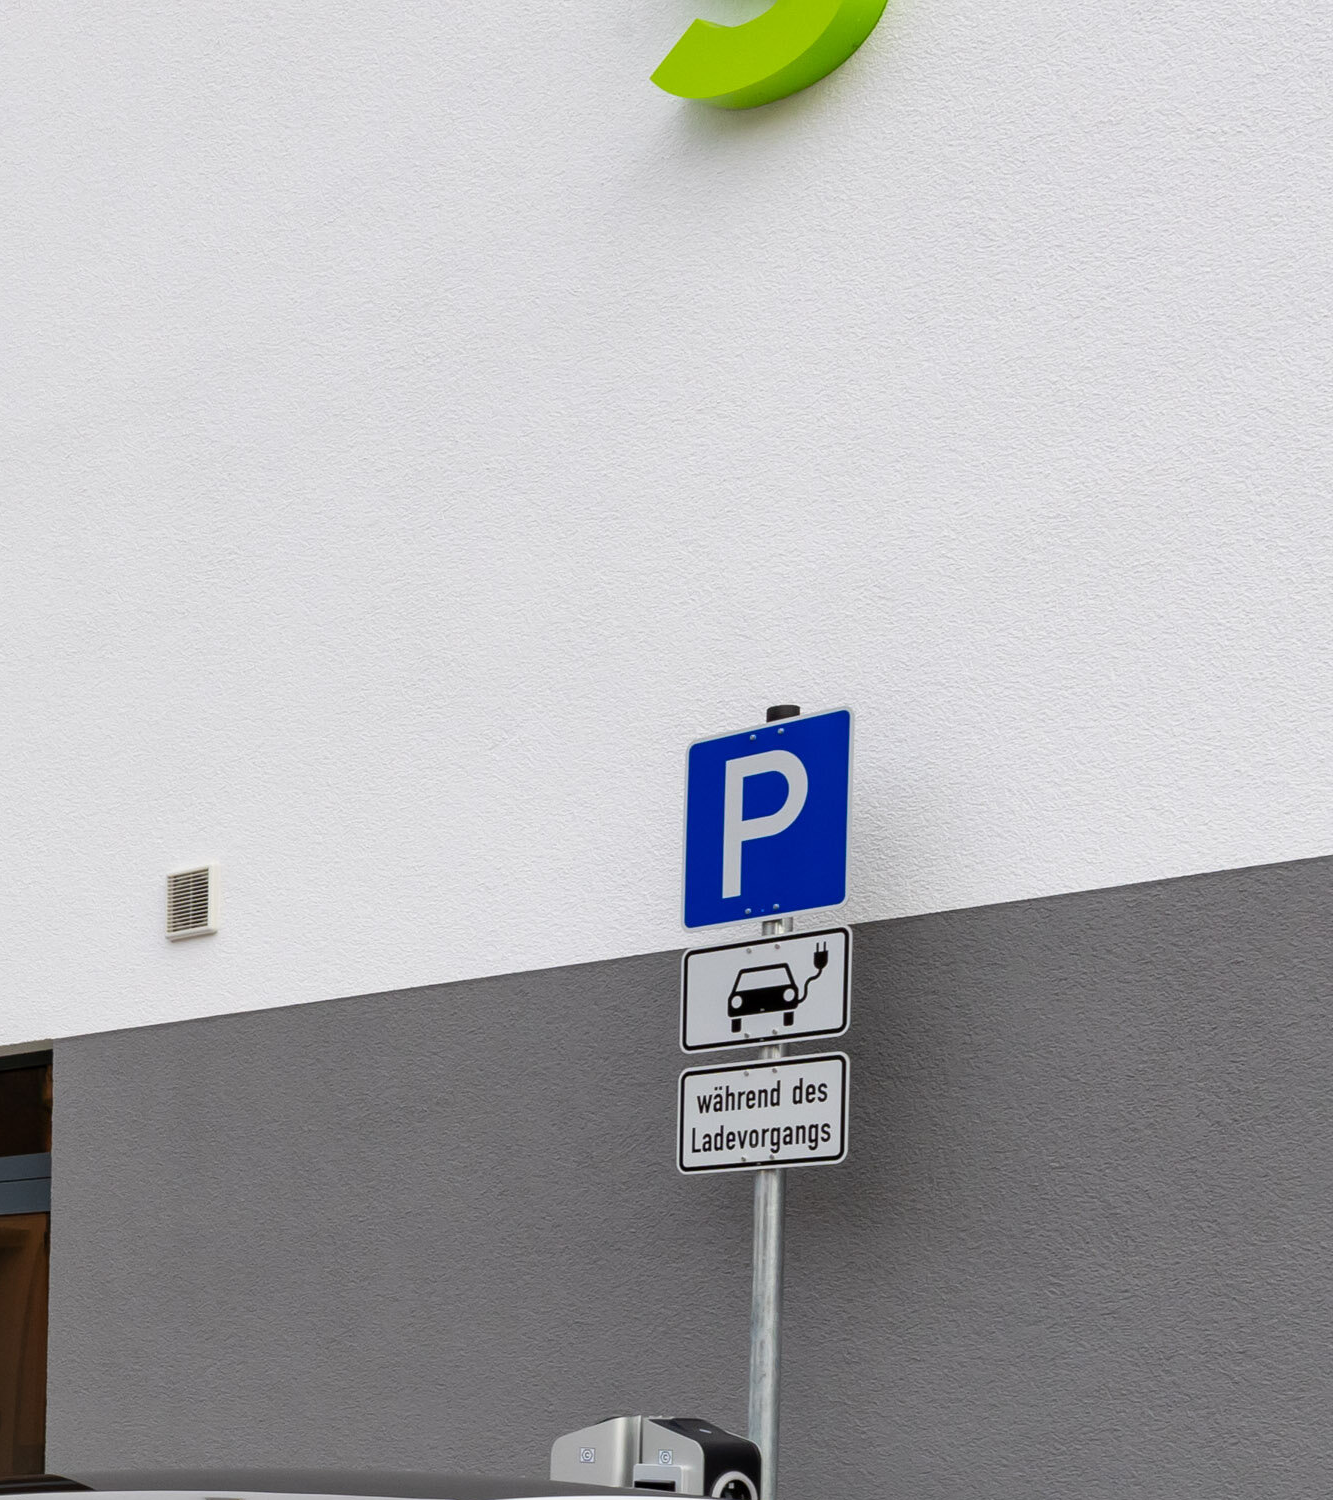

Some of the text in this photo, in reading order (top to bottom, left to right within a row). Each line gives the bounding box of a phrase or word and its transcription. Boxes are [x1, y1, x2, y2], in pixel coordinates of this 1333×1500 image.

[722, 750, 808, 898] P
[696, 1078, 829, 1114] während des
[691, 1122, 831, 1153] Ladevorgangs
